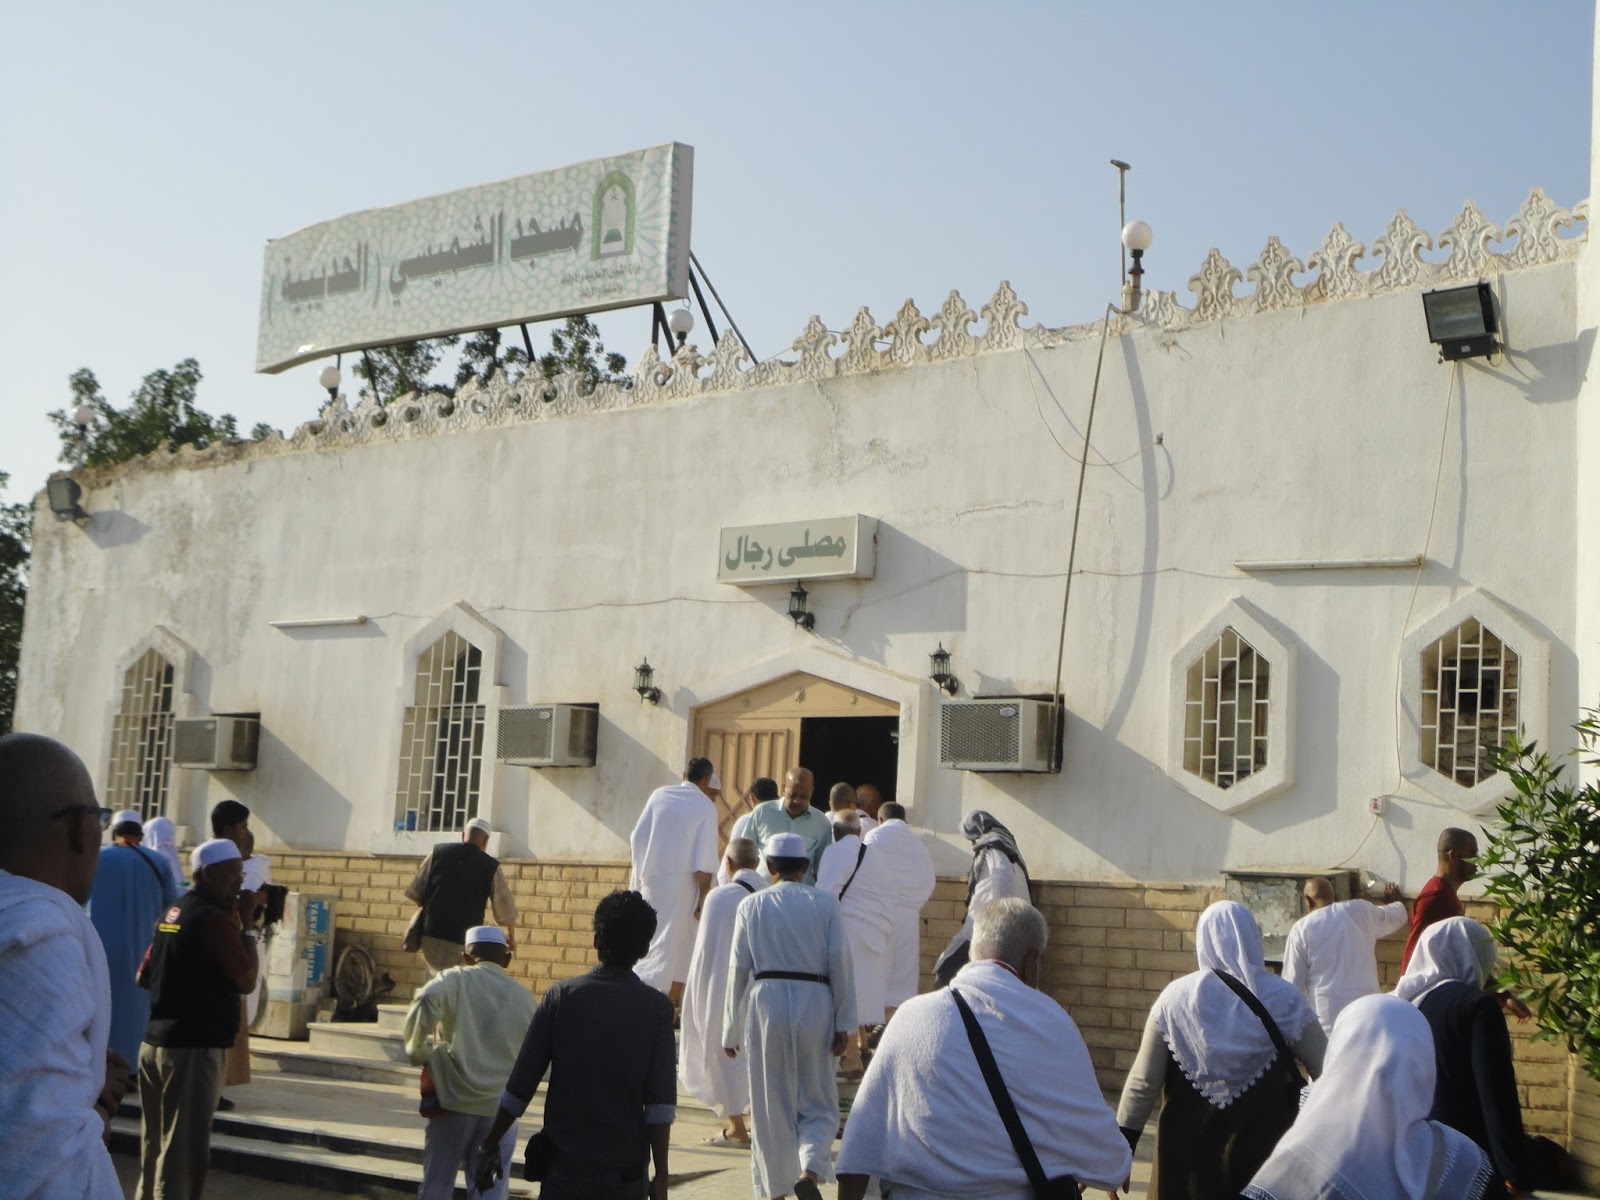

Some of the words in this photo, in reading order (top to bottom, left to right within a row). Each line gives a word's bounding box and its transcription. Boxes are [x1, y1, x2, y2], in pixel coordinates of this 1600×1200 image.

[389, 210, 504, 307] الشميسي
[510, 211, 584, 271] مسجد
[725, 534, 773, 571] رجال
[309, 903, 319, 935] TAKVA
